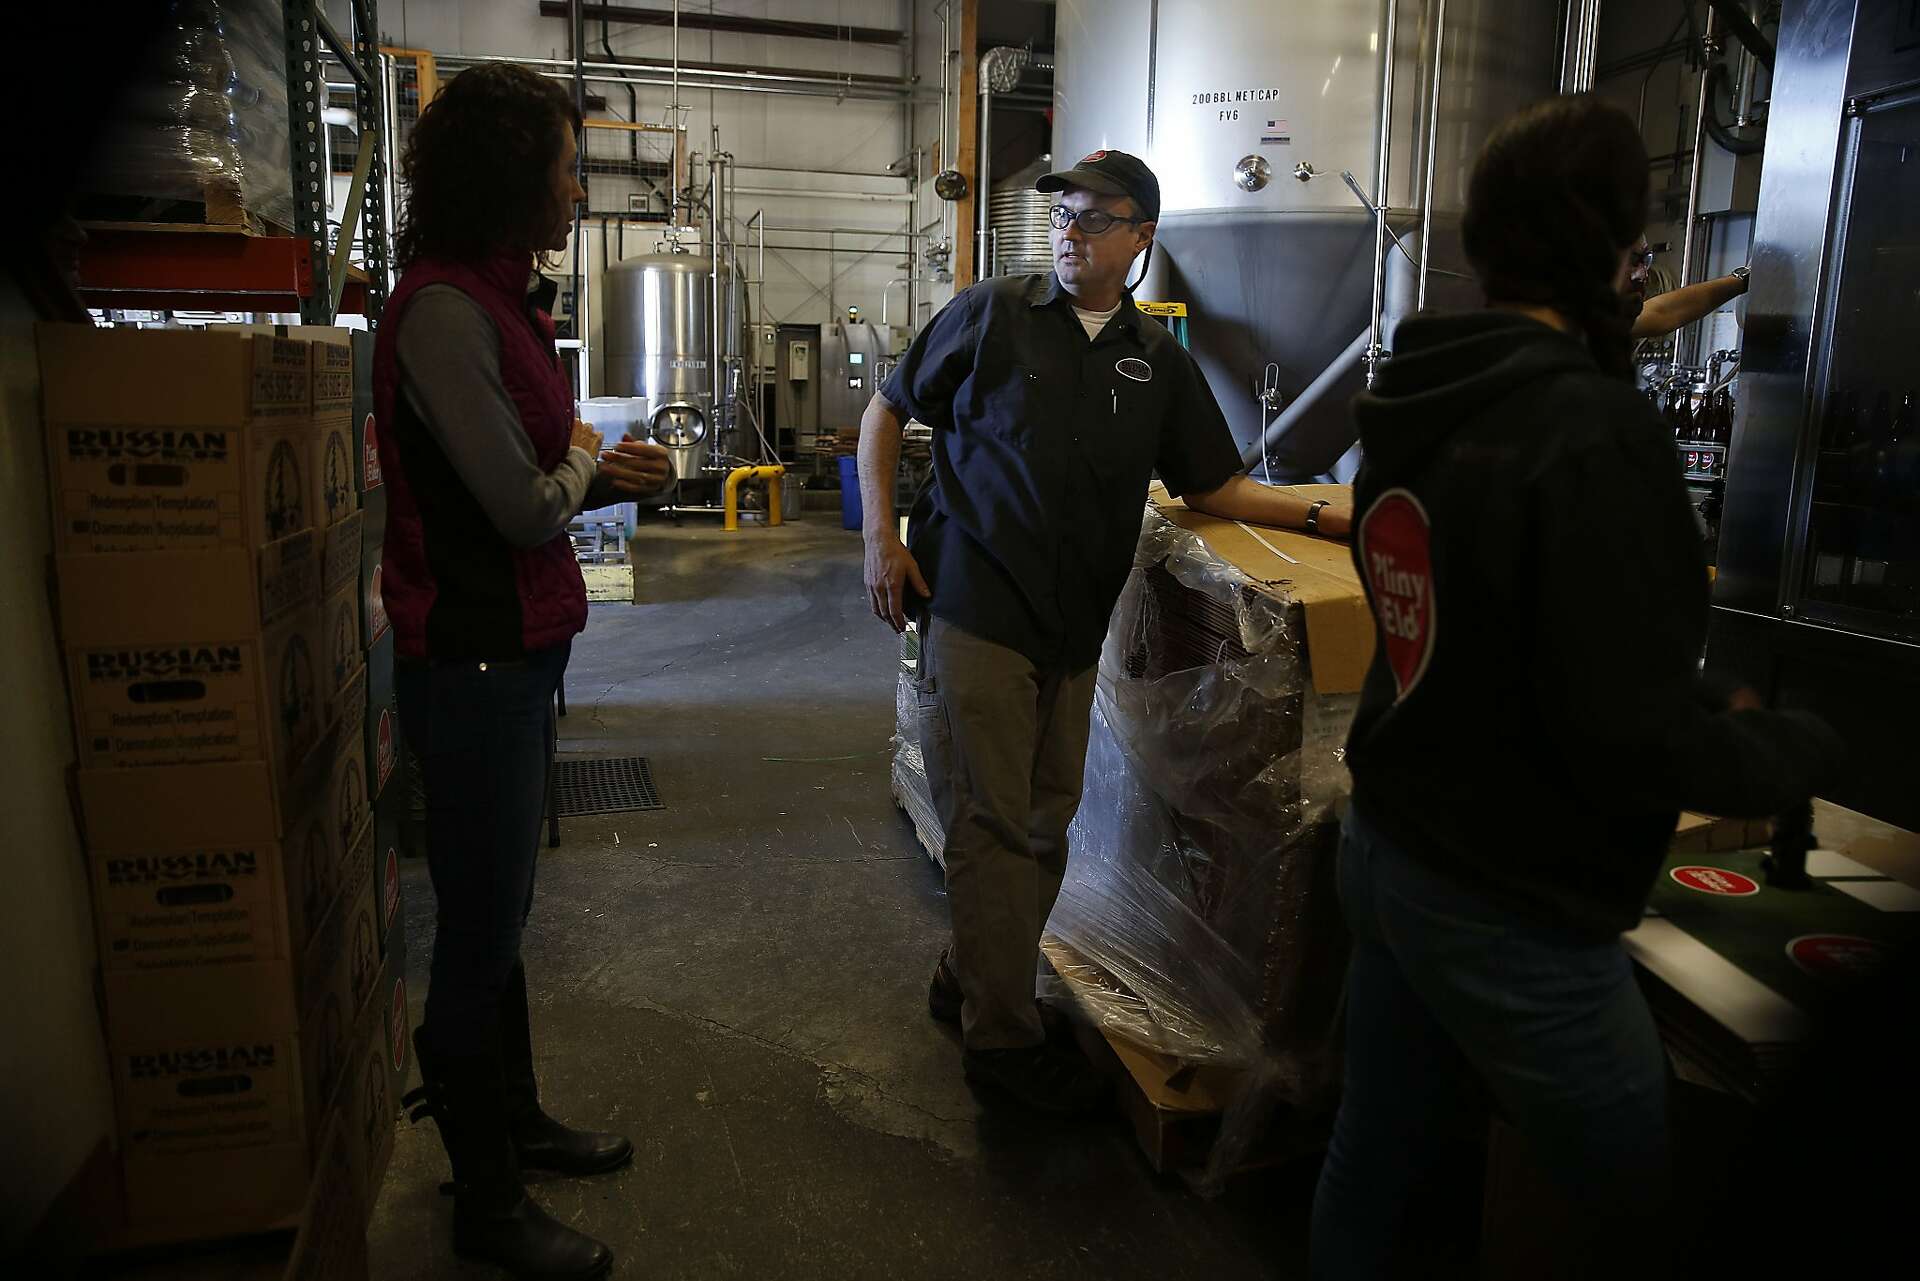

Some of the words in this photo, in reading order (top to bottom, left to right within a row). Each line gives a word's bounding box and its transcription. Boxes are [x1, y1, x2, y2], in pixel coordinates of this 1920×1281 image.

[1192, 93, 1211, 104] 200
[1213, 92, 1231, 103] BBL
[1235, 90, 1255, 101] NET
[1258, 89, 1279, 100] CAP
[1219, 109, 1239, 121] FV6
[68, 430, 227, 448] RUSSIAN
[88, 646, 241, 668] RUSSIAN
[107, 851, 256, 875] RUSSIAN
[130, 1044, 275, 1069] RUSSIAN
